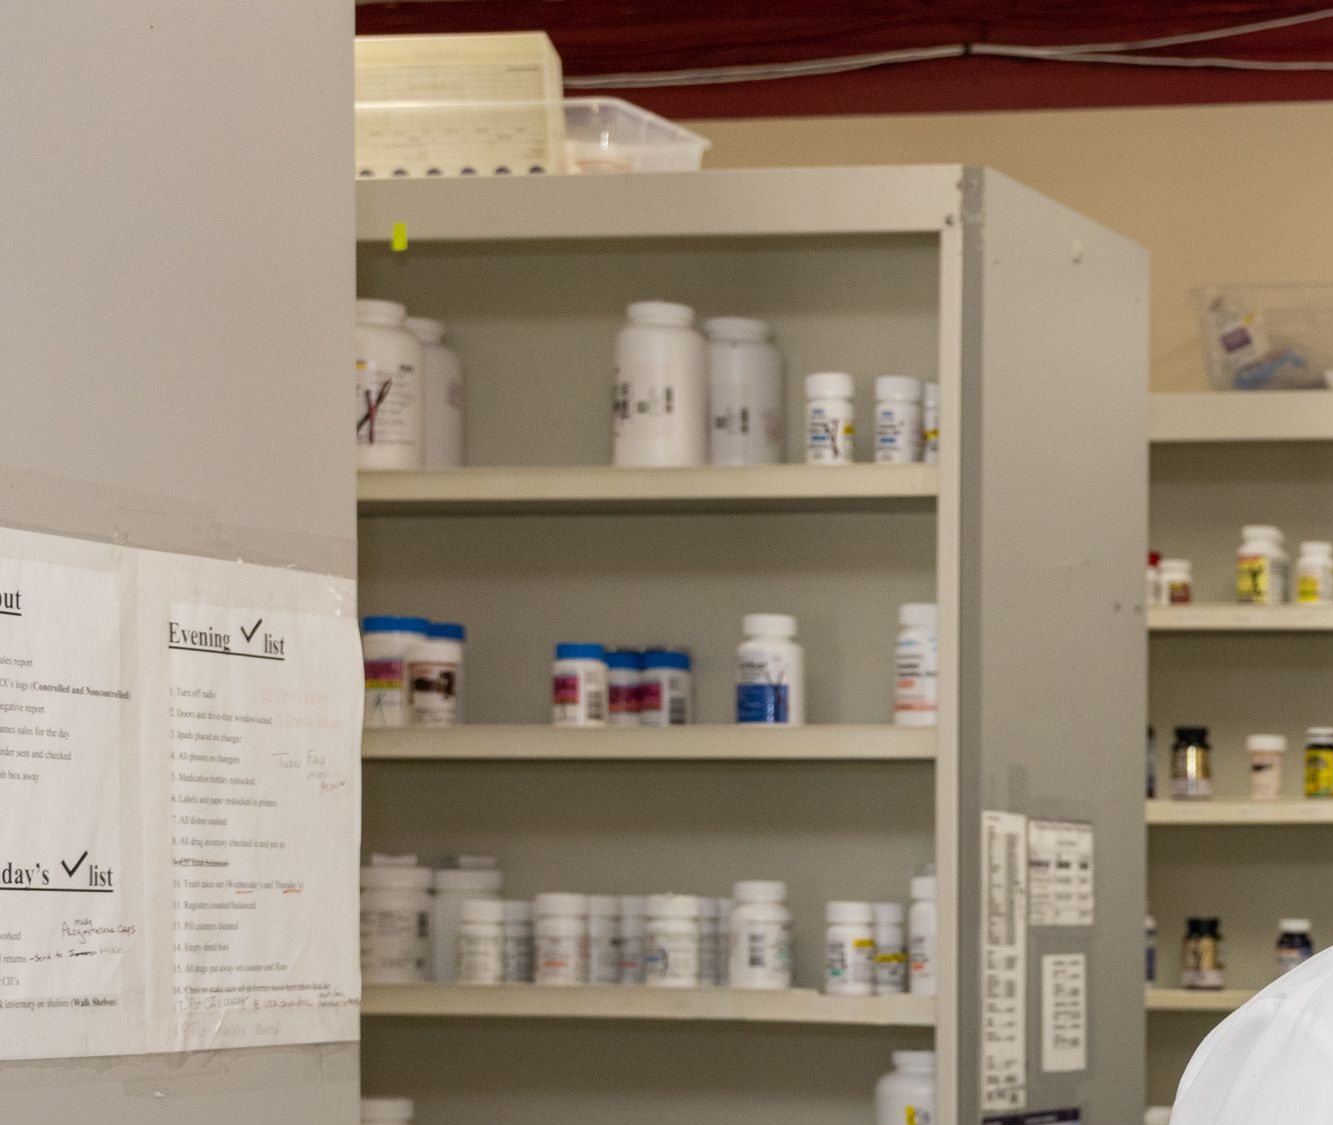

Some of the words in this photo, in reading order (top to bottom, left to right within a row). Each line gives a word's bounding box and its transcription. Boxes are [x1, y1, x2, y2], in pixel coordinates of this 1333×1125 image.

[0, 590, 21, 610] ut
[169, 622, 231, 654] Evening
[264, 633, 285, 656] list
[72, 686, 84, 695] and
[25, 704, 45, 715] report
[35, 726, 45, 736] for
[46, 727, 57, 738] the
[58, 728, 70, 740] day
[31, 750, 44, 759] and
[45, 751, 72, 761] checked
[2, 862, 50, 889] day's
[89, 864, 113, 887] list
